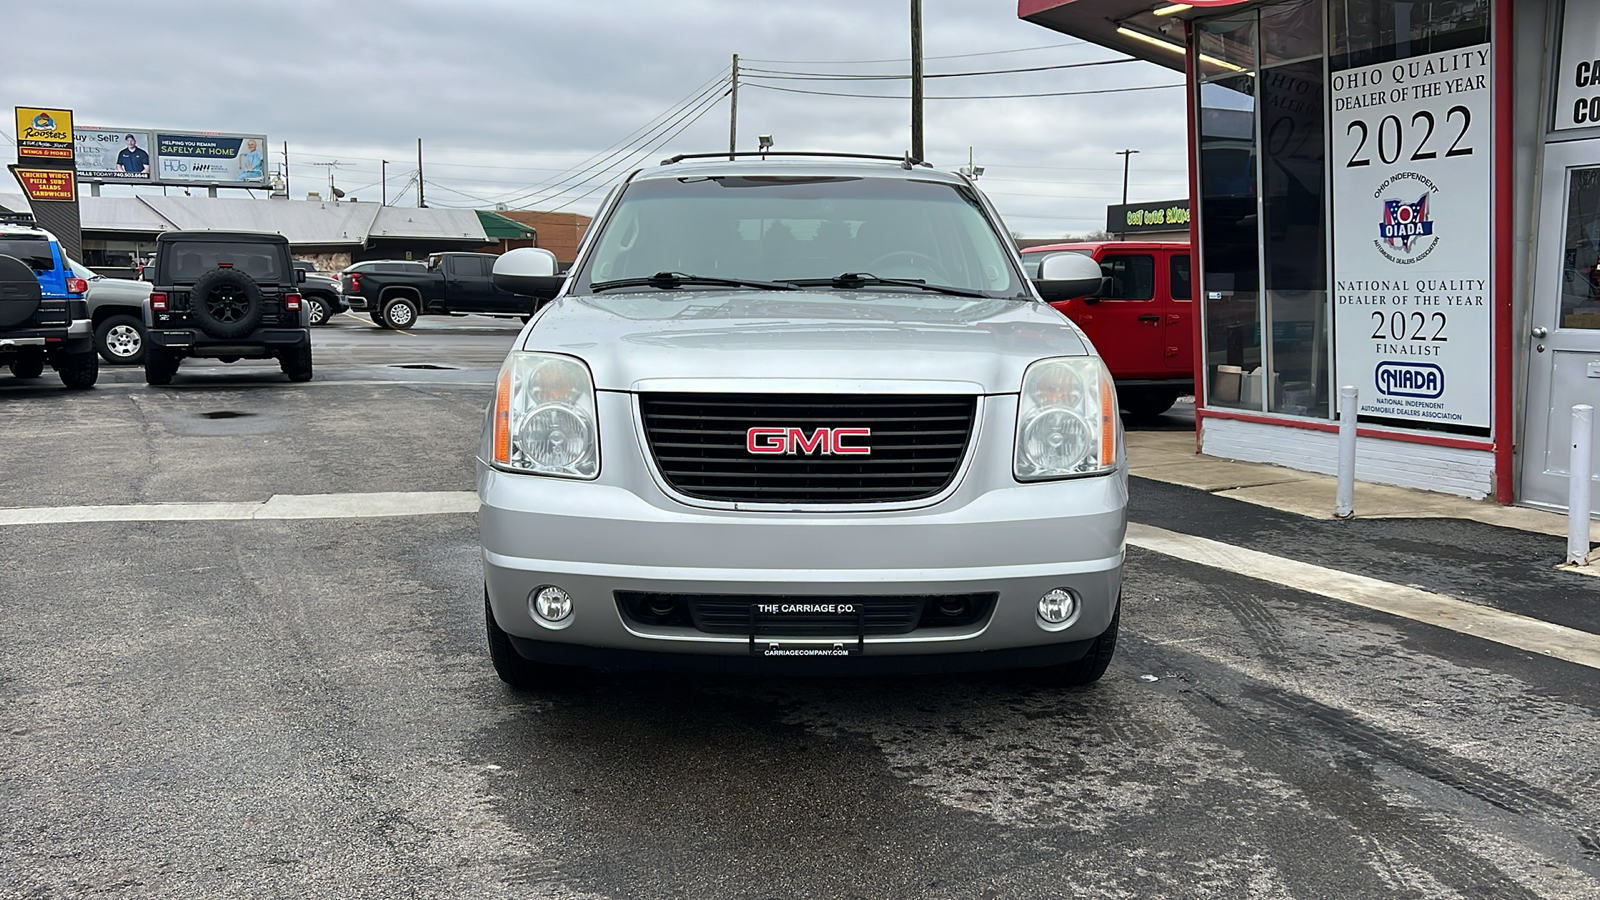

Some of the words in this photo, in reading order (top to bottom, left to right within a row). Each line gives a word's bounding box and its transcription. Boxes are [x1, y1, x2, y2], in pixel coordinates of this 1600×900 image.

[1333, 69, 1382, 91] OHIO
[1392, 49, 1489, 83] QUALITY
[1335, 91, 1387, 111] DEALER
[1390, 87, 1409, 102] OF
[1412, 82, 1441, 99] THE
[1445, 74, 1486, 94] YEAR
[1573, 96, 1600, 124] CO
[23, 127, 67, 140] Roosters
[73, 134, 87, 142] uy
[97, 134, 119, 142] Sell?
[1346, 105, 1473, 168] 2022
[161, 146, 194, 154] SAFELY
[1374, 180, 1390, 199] OHIO
[1390, 172, 1439, 194] INDEPENDENT
[1386, 223, 1424, 236] OIADA
[1373, 239, 1396, 262] AUTOMOBILE
[1415, 236, 1440, 261] ASSOCIATION
[1337, 280, 1409, 291] NATIONAL
[1416, 280, 1485, 293] QUALITY
[1339, 295, 1386, 305] DEALER
[1392, 295, 1408, 305] OF
[1414, 296, 1440, 306] THE
[1447, 296, 1483, 306] YEAR
[1371, 311, 1448, 342] 2022
[1376, 344, 1441, 356] FINALIST
[1381, 368, 1437, 391] NIADA
[1376, 398, 1404, 406] NATIONAL
[1405, 400, 1444, 409] INDEPENDENT
[1361, 405, 1395, 414] AUTOMOBILE
[1396, 408, 1420, 417] DEALERS
[1421, 411, 1462, 420] ASSOCIATION
[747, 426, 871, 455] GMC
[758, 604, 779, 613] THE
[781, 604, 835, 613] CARRIAGE
[837, 604, 856, 613] CO.
